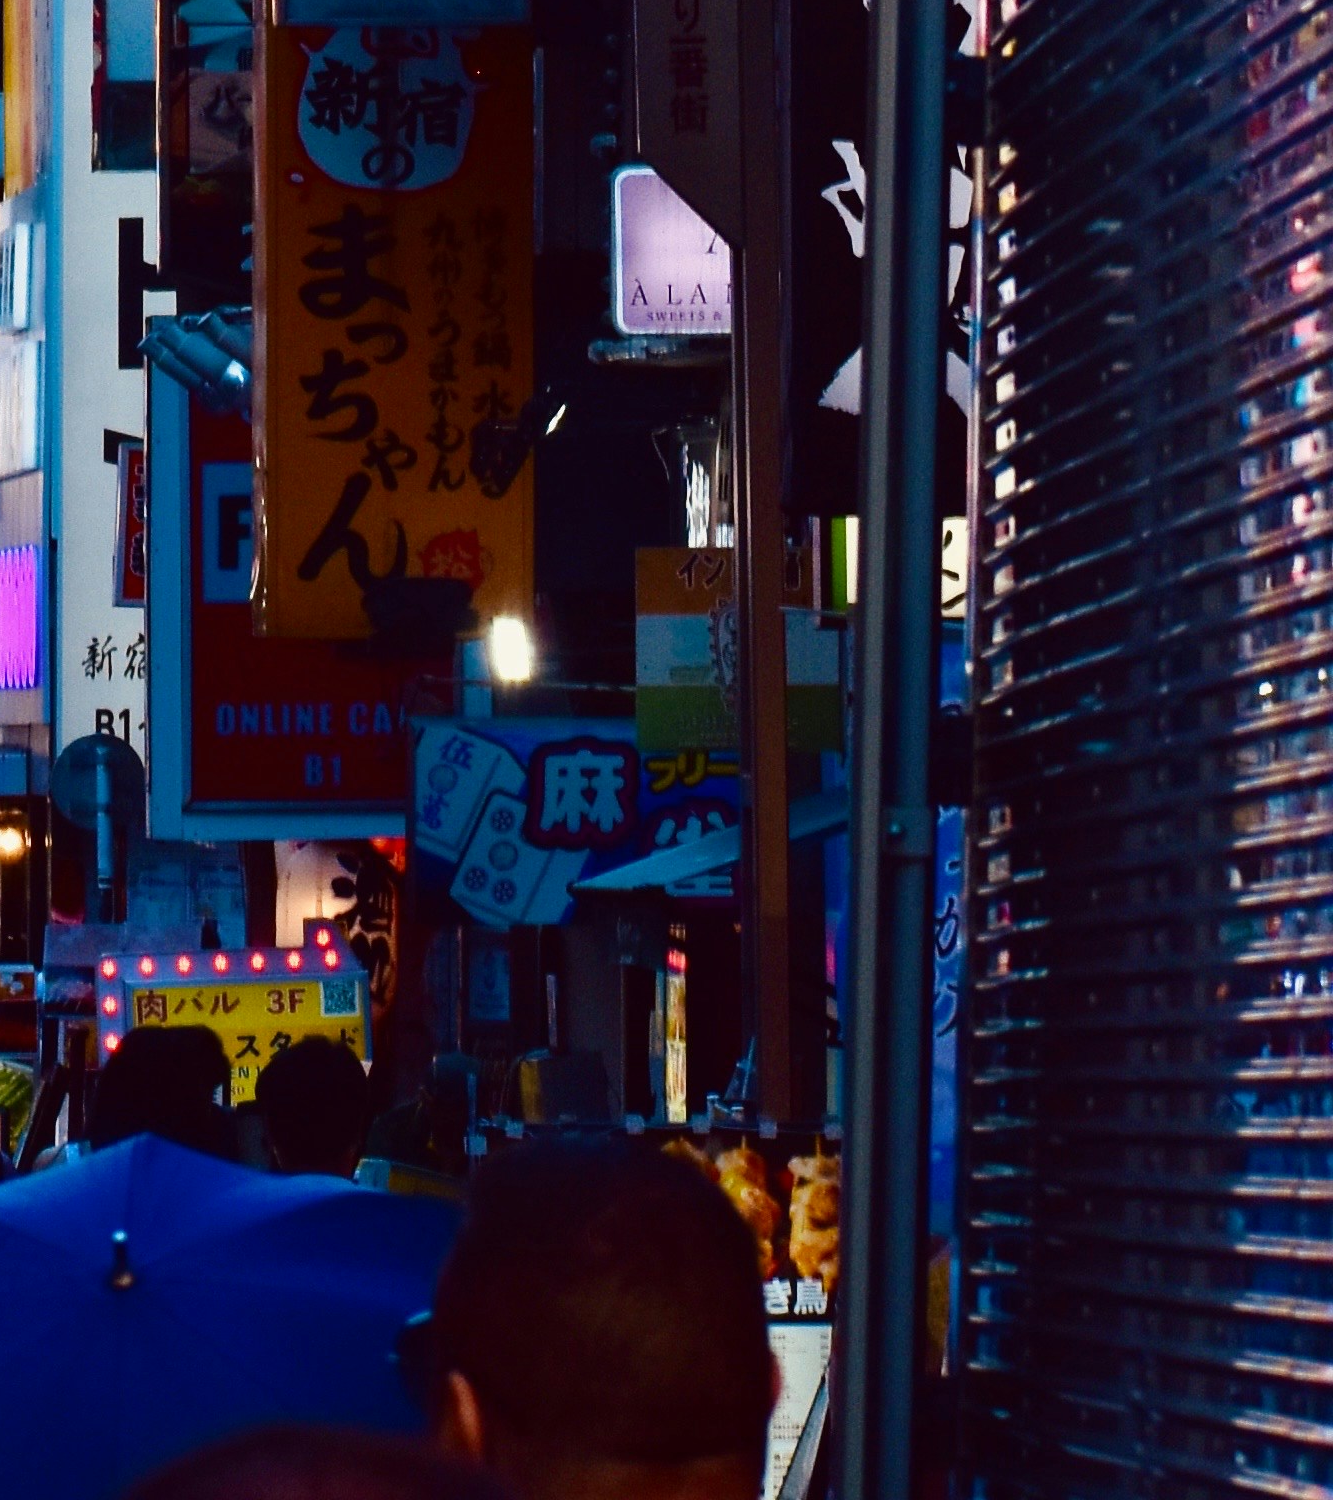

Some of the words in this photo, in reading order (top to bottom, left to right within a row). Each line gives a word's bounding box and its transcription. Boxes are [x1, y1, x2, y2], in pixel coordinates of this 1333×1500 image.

[645, 311, 706, 323] SWEETS
[297, 202, 419, 583] まっちゃん
[213, 701, 332, 737] ONLINE
[539, 748, 627, 834] 麻
[134, 989, 242, 1025] 肉バル
[265, 987, 307, 1016] 3F
